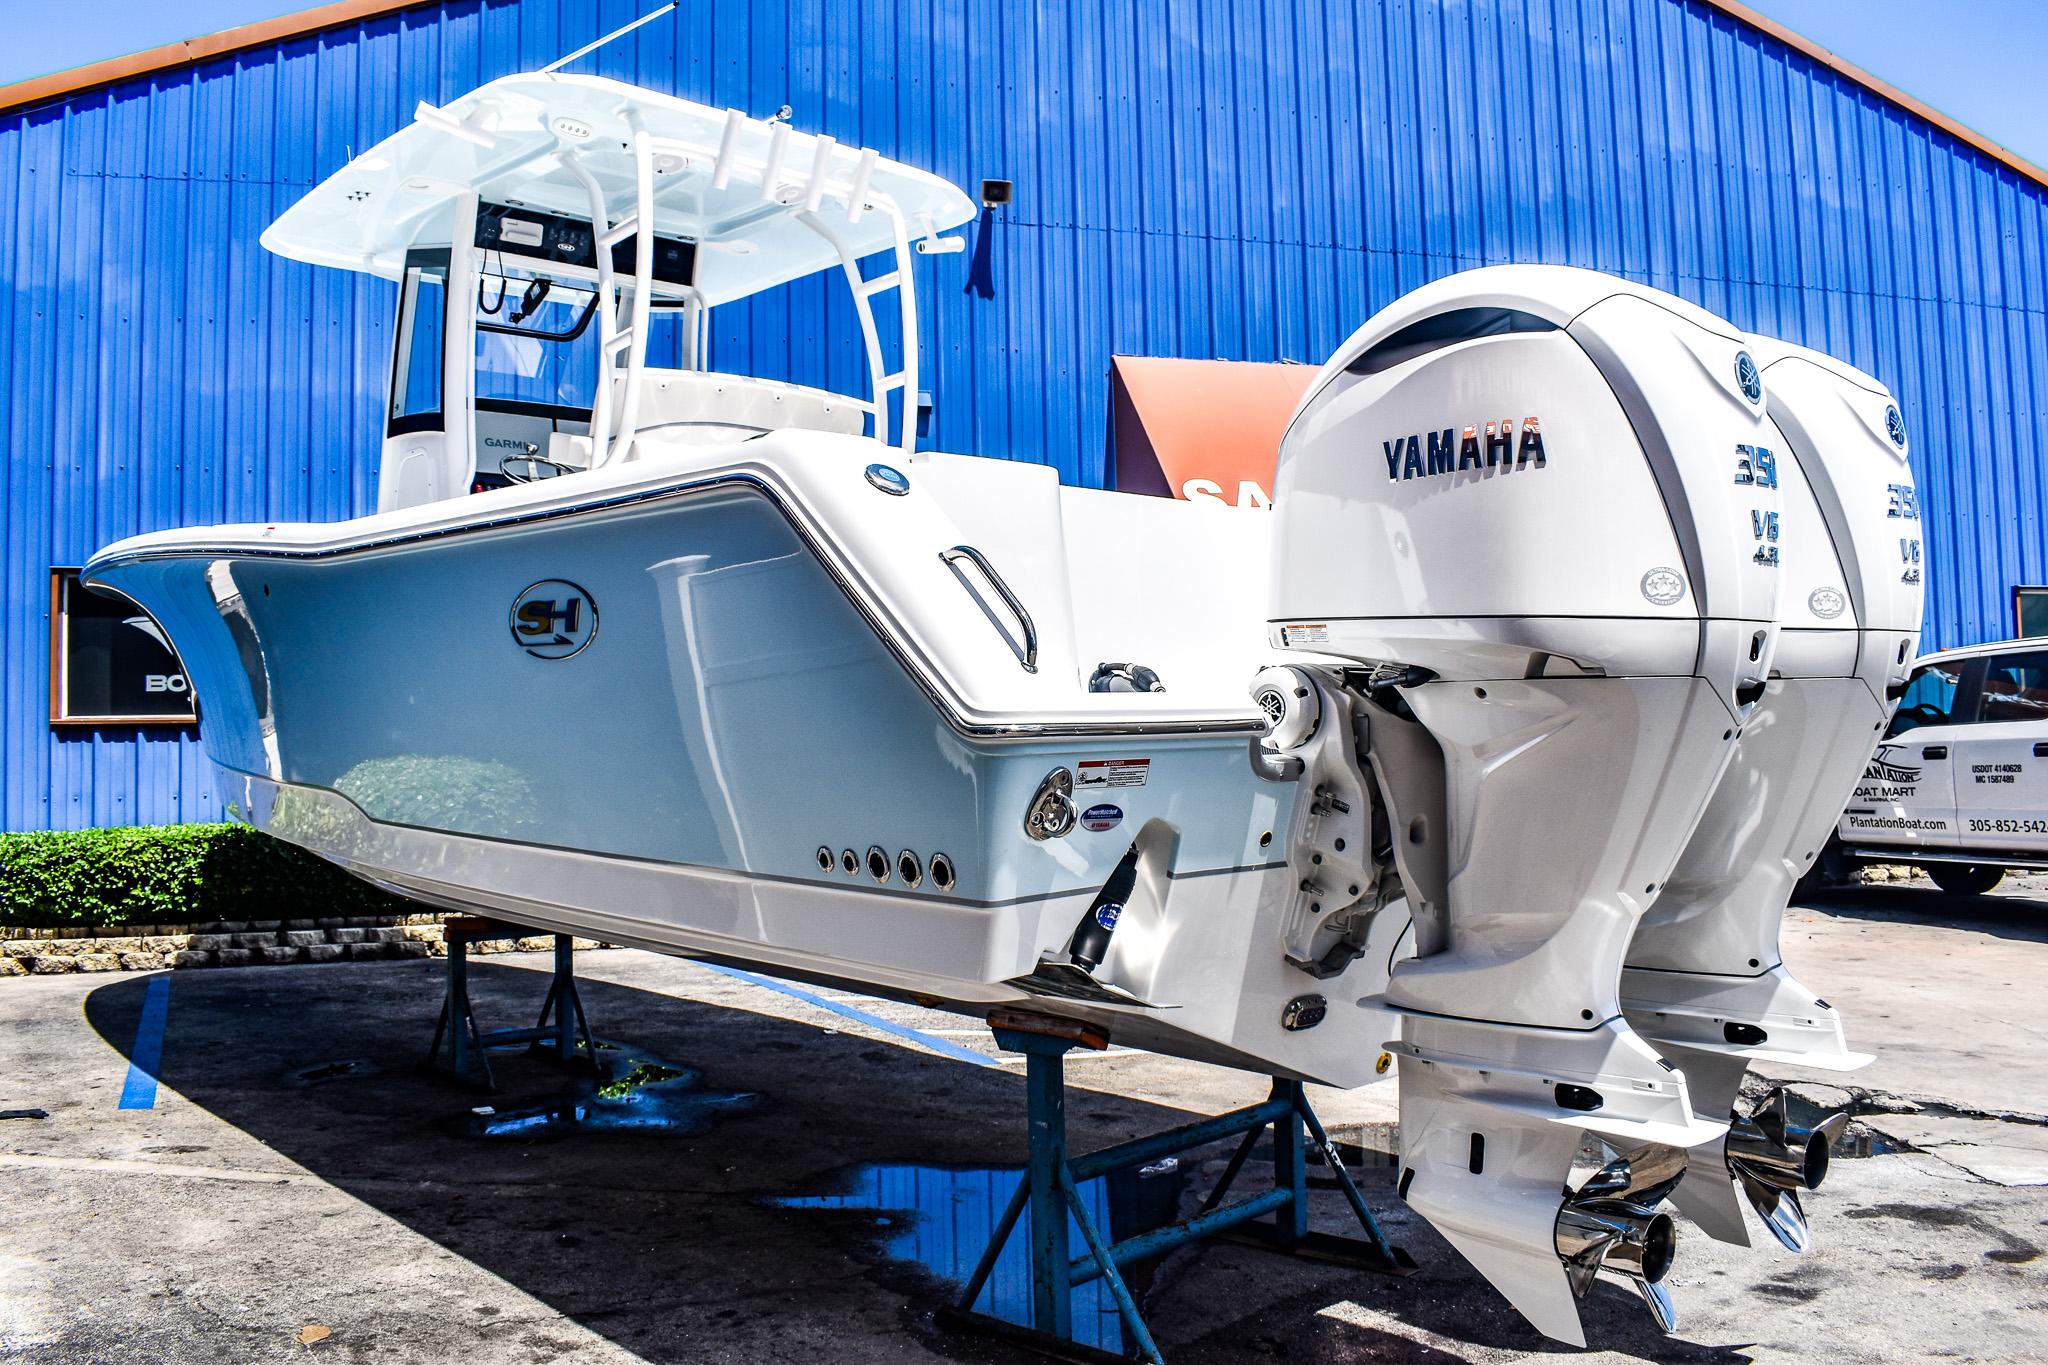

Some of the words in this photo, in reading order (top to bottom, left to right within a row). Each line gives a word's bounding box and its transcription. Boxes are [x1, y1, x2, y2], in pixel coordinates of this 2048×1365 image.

[485, 438, 533, 450] GARMI
[1383, 416, 1547, 482] YAMAHA
[1751, 509, 1779, 543] V6
[1900, 538, 1920, 566] V6
[517, 598, 581, 635] SH
[1863, 763, 1915, 782] ANTATION
[1972, 765, 1993, 773] USDOT
[1853, 787, 1878, 796] OAT
[1881, 787, 1916, 796] MART
[1850, 816, 1947, 830] PlantationBoat.com
[1969, 819, 2048, 833] 305-852-542
